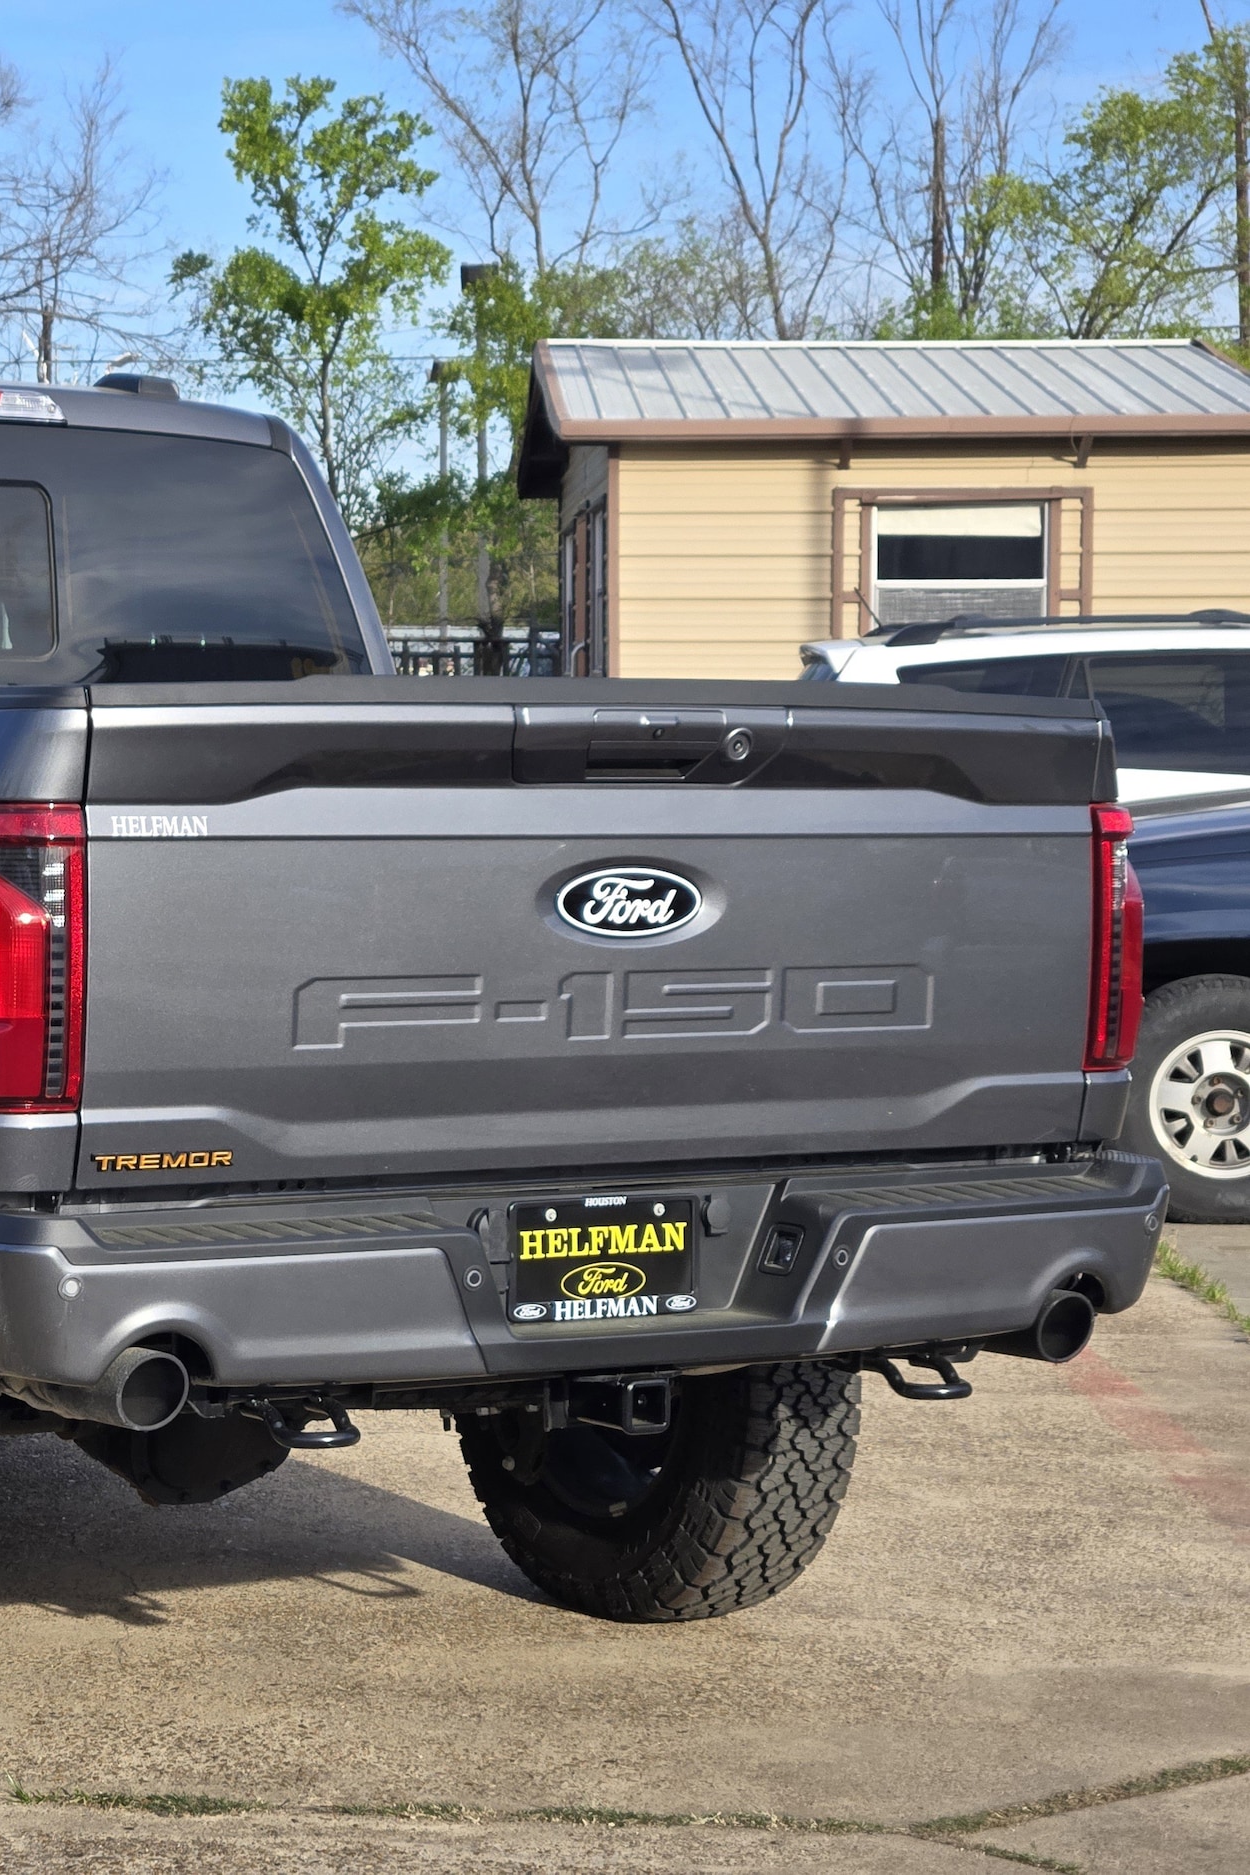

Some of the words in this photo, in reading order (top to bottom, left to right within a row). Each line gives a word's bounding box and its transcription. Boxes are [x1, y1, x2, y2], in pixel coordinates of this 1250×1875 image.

[111, 815, 208, 837] HELFMAN
[582, 876, 678, 925] Ford
[292, 963, 935, 1051] F-150
[93, 1150, 234, 1172] TREMOR
[584, 1195, 628, 1207] HOUSTON
[519, 1221, 688, 1261] HELFMAN
[577, 1266, 629, 1295] Ford
[554, 1294, 660, 1321] HELFMAN
